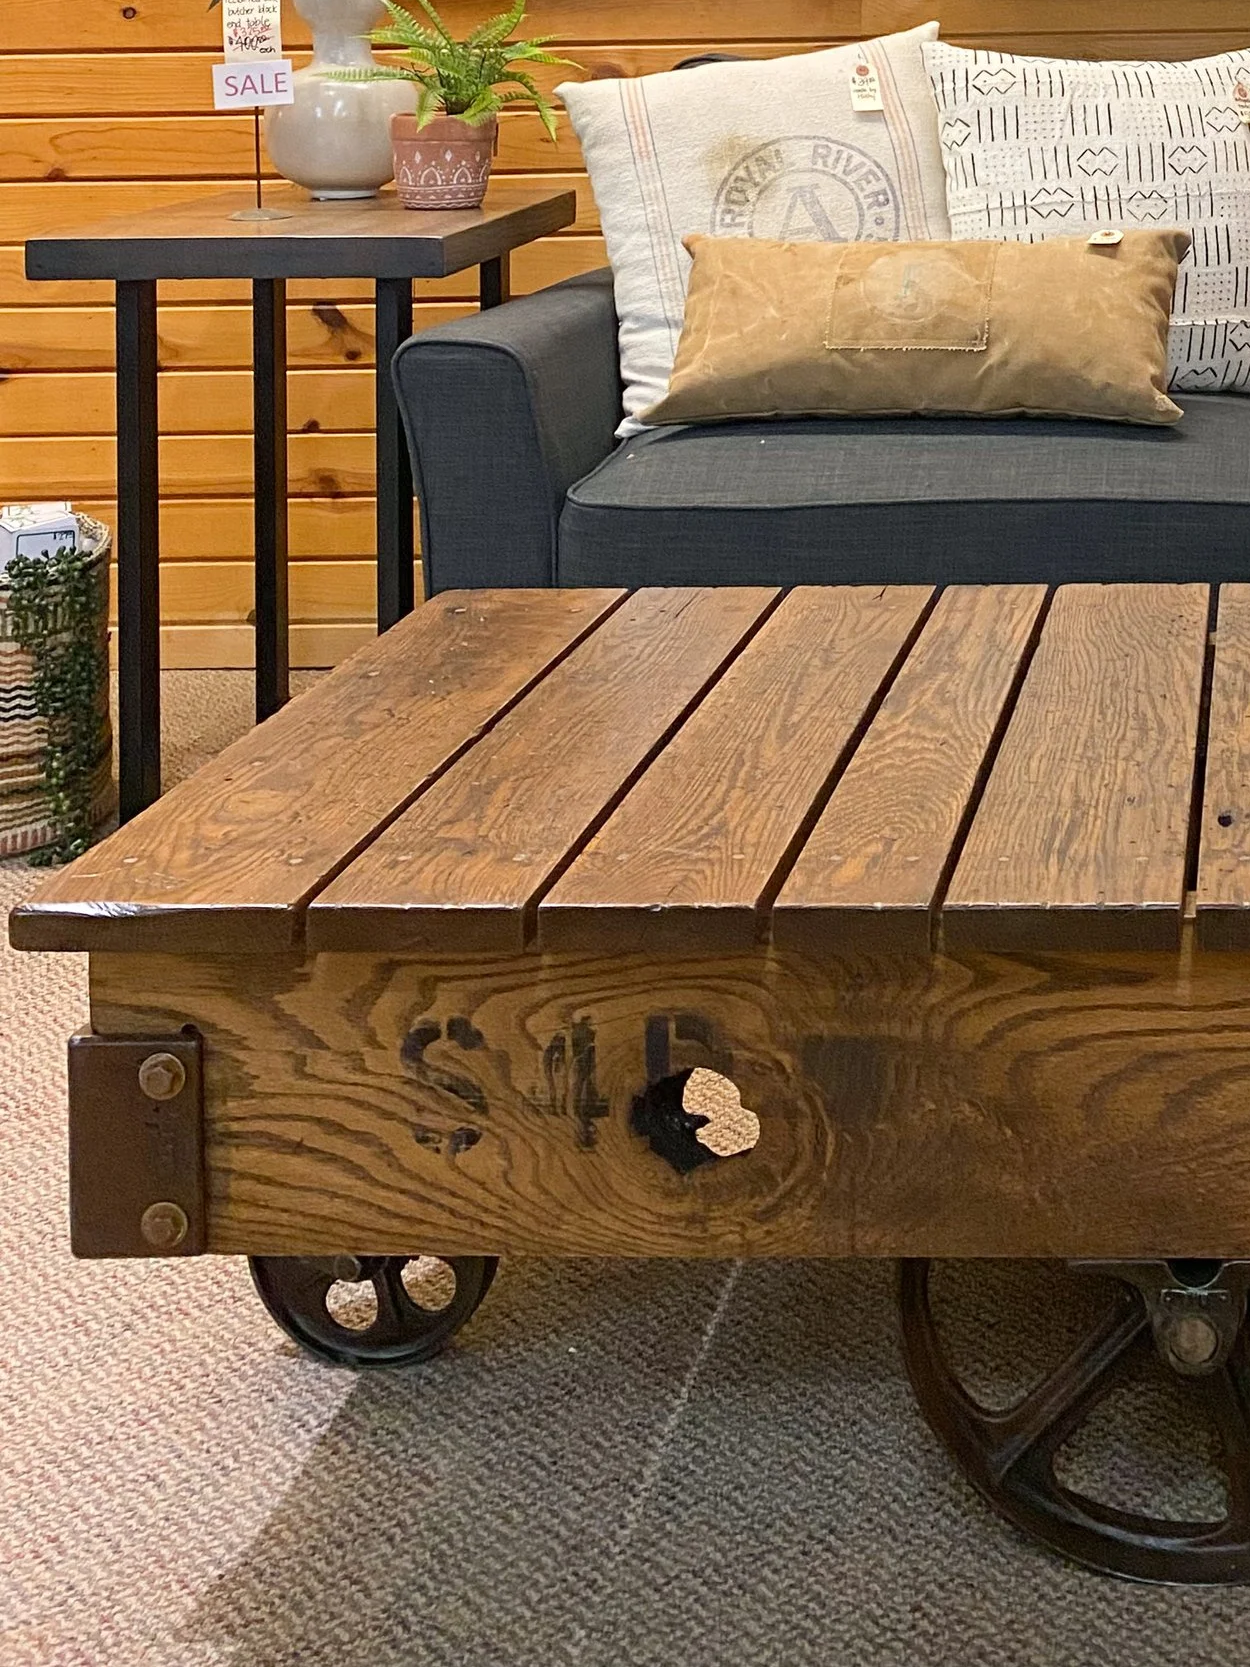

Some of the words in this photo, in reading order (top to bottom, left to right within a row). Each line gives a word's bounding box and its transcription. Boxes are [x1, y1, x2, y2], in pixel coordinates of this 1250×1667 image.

[227, 6, 254, 16] butcher
[258, 4, 277, 13] block
[227, 19, 241, 28] end
[246, 18, 270, 28] table
[259, 46, 276, 54] each
[225, 72, 288, 97] SALE
[811, 144, 889, 213] RIVER
